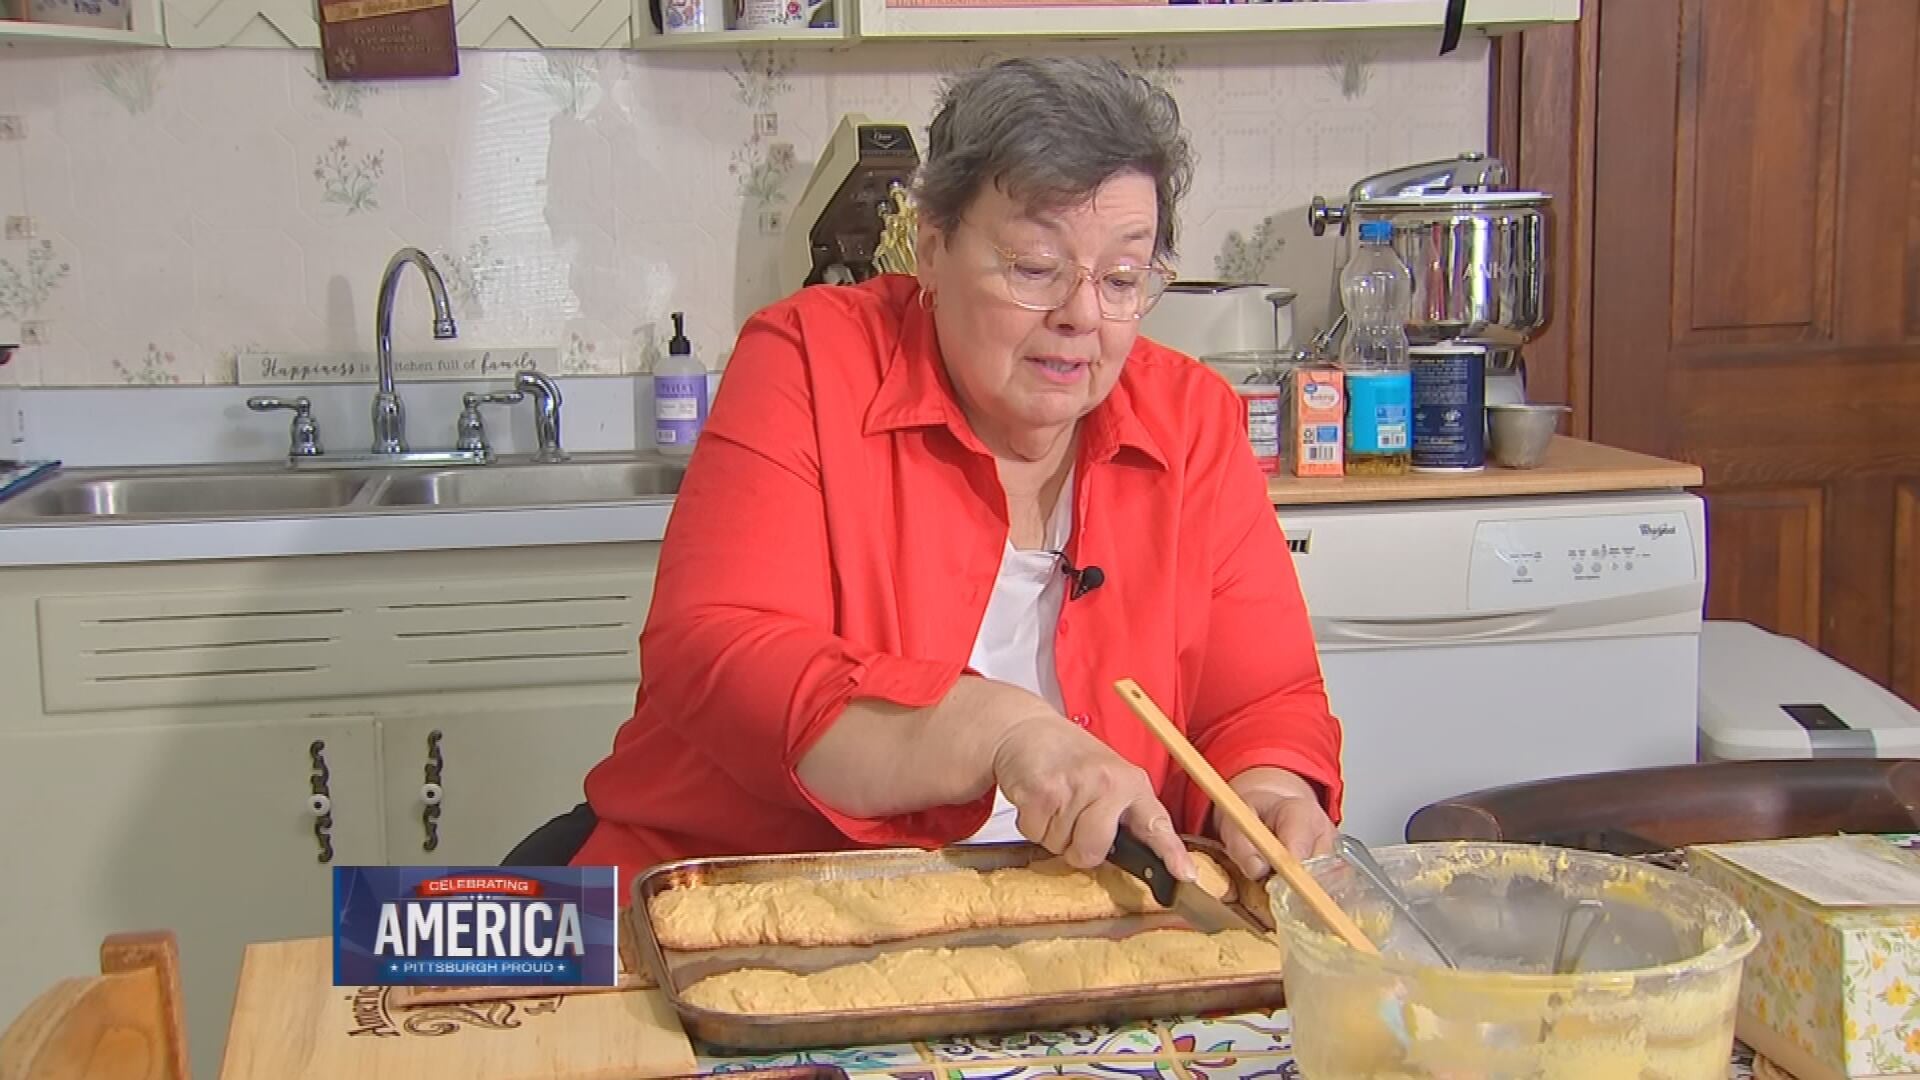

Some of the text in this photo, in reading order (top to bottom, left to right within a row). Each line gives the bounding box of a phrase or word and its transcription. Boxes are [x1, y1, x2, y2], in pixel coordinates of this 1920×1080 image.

[262, 357, 355, 380] Happiness
[394, 359, 433, 372] itchen
[438, 359, 459, 371] full
[463, 358, 476, 370] of
[481, 351, 537, 374] family
